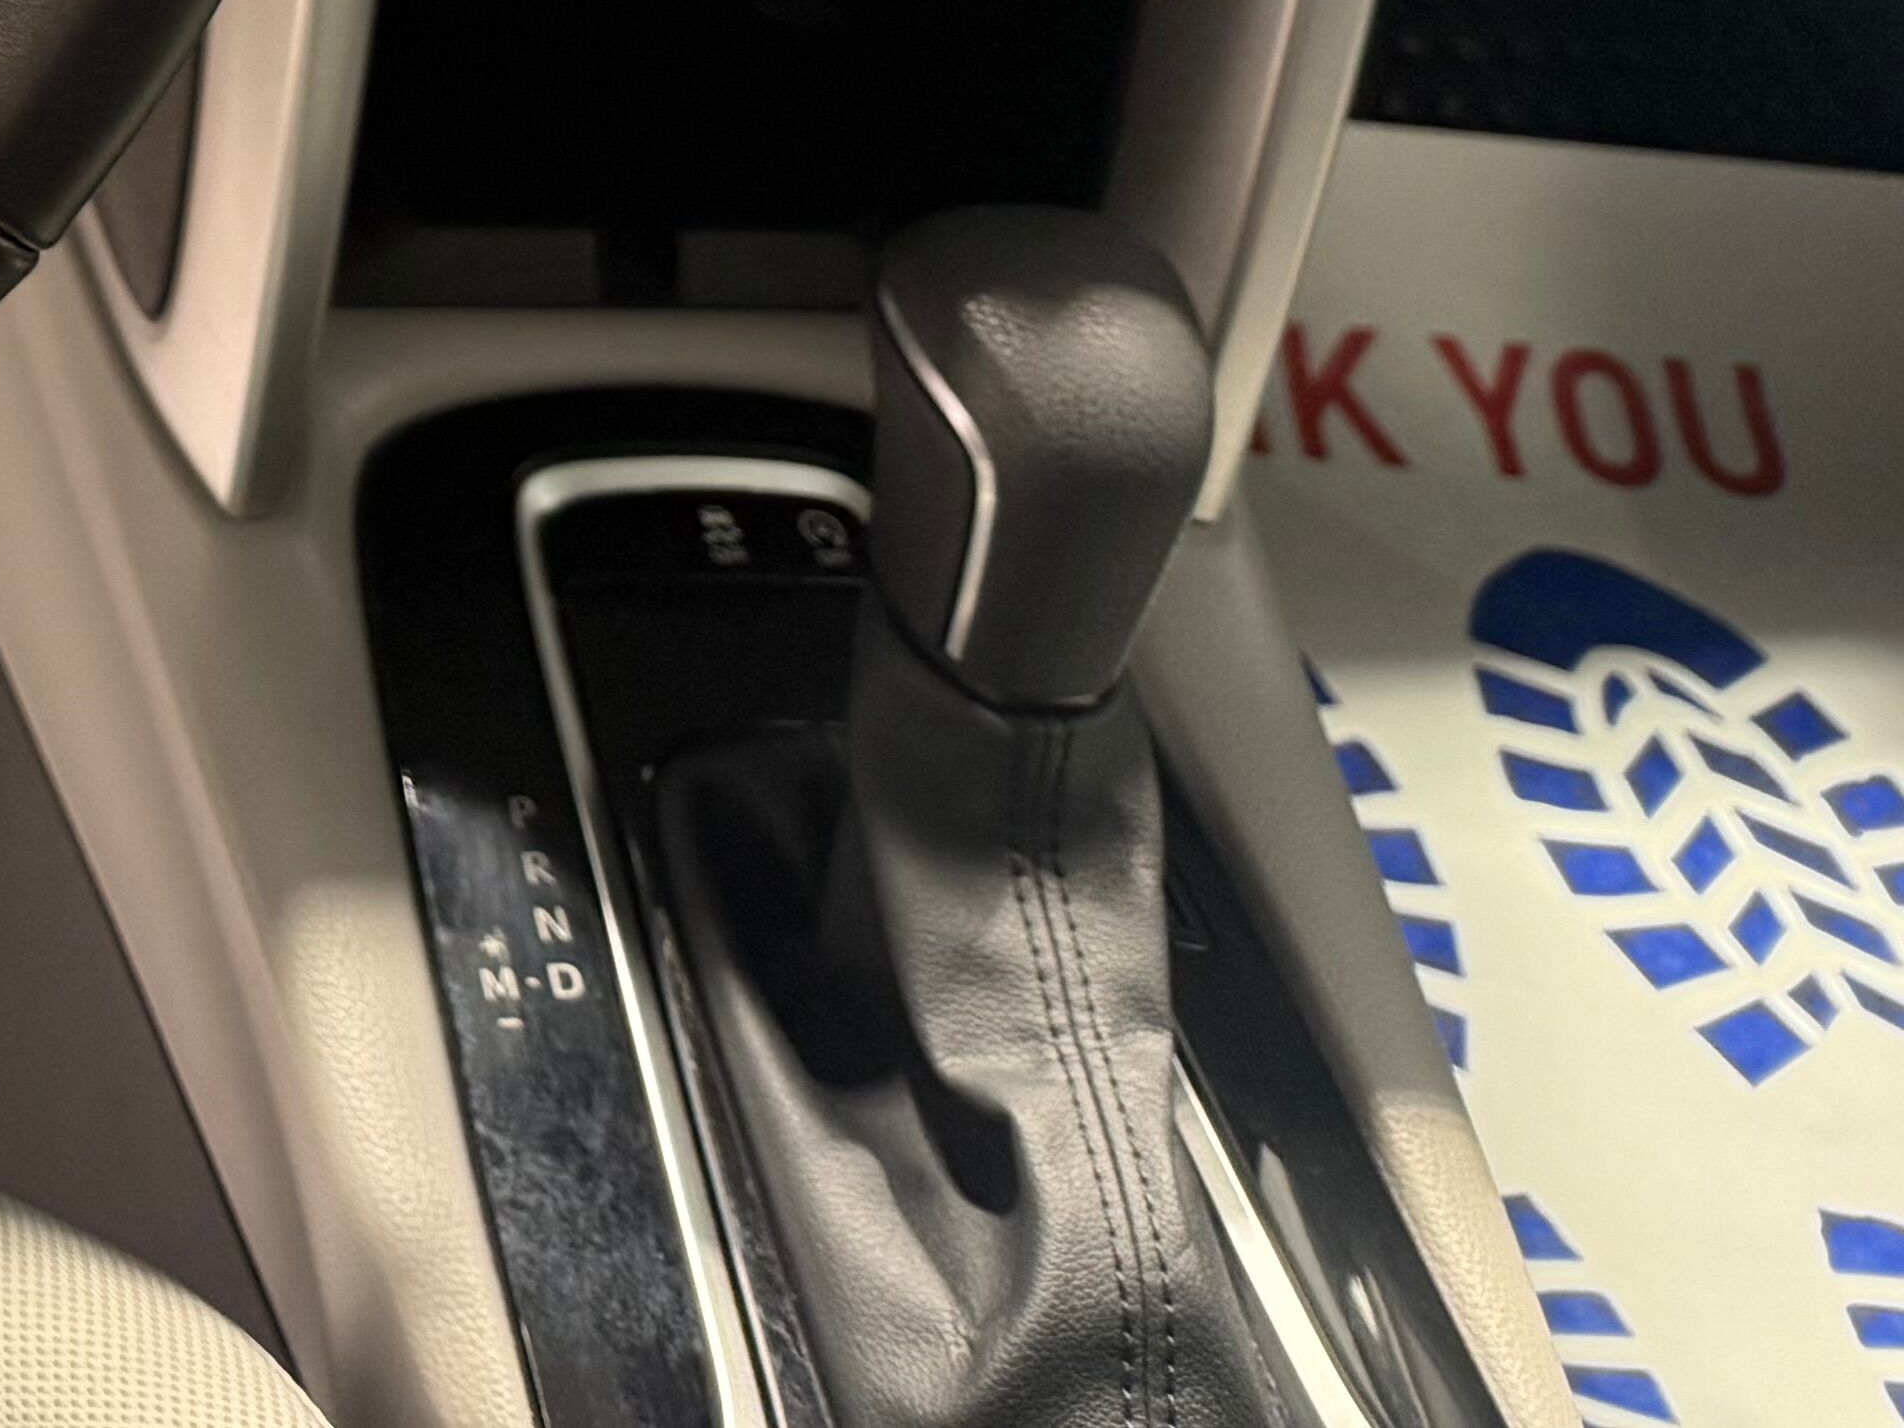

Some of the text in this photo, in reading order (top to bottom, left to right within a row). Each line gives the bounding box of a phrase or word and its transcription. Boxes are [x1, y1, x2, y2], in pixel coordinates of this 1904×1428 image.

[1427, 331, 1790, 499] YOU
[507, 795, 537, 829] P
[521, 850, 556, 886] R
[532, 905, 575, 943] N
